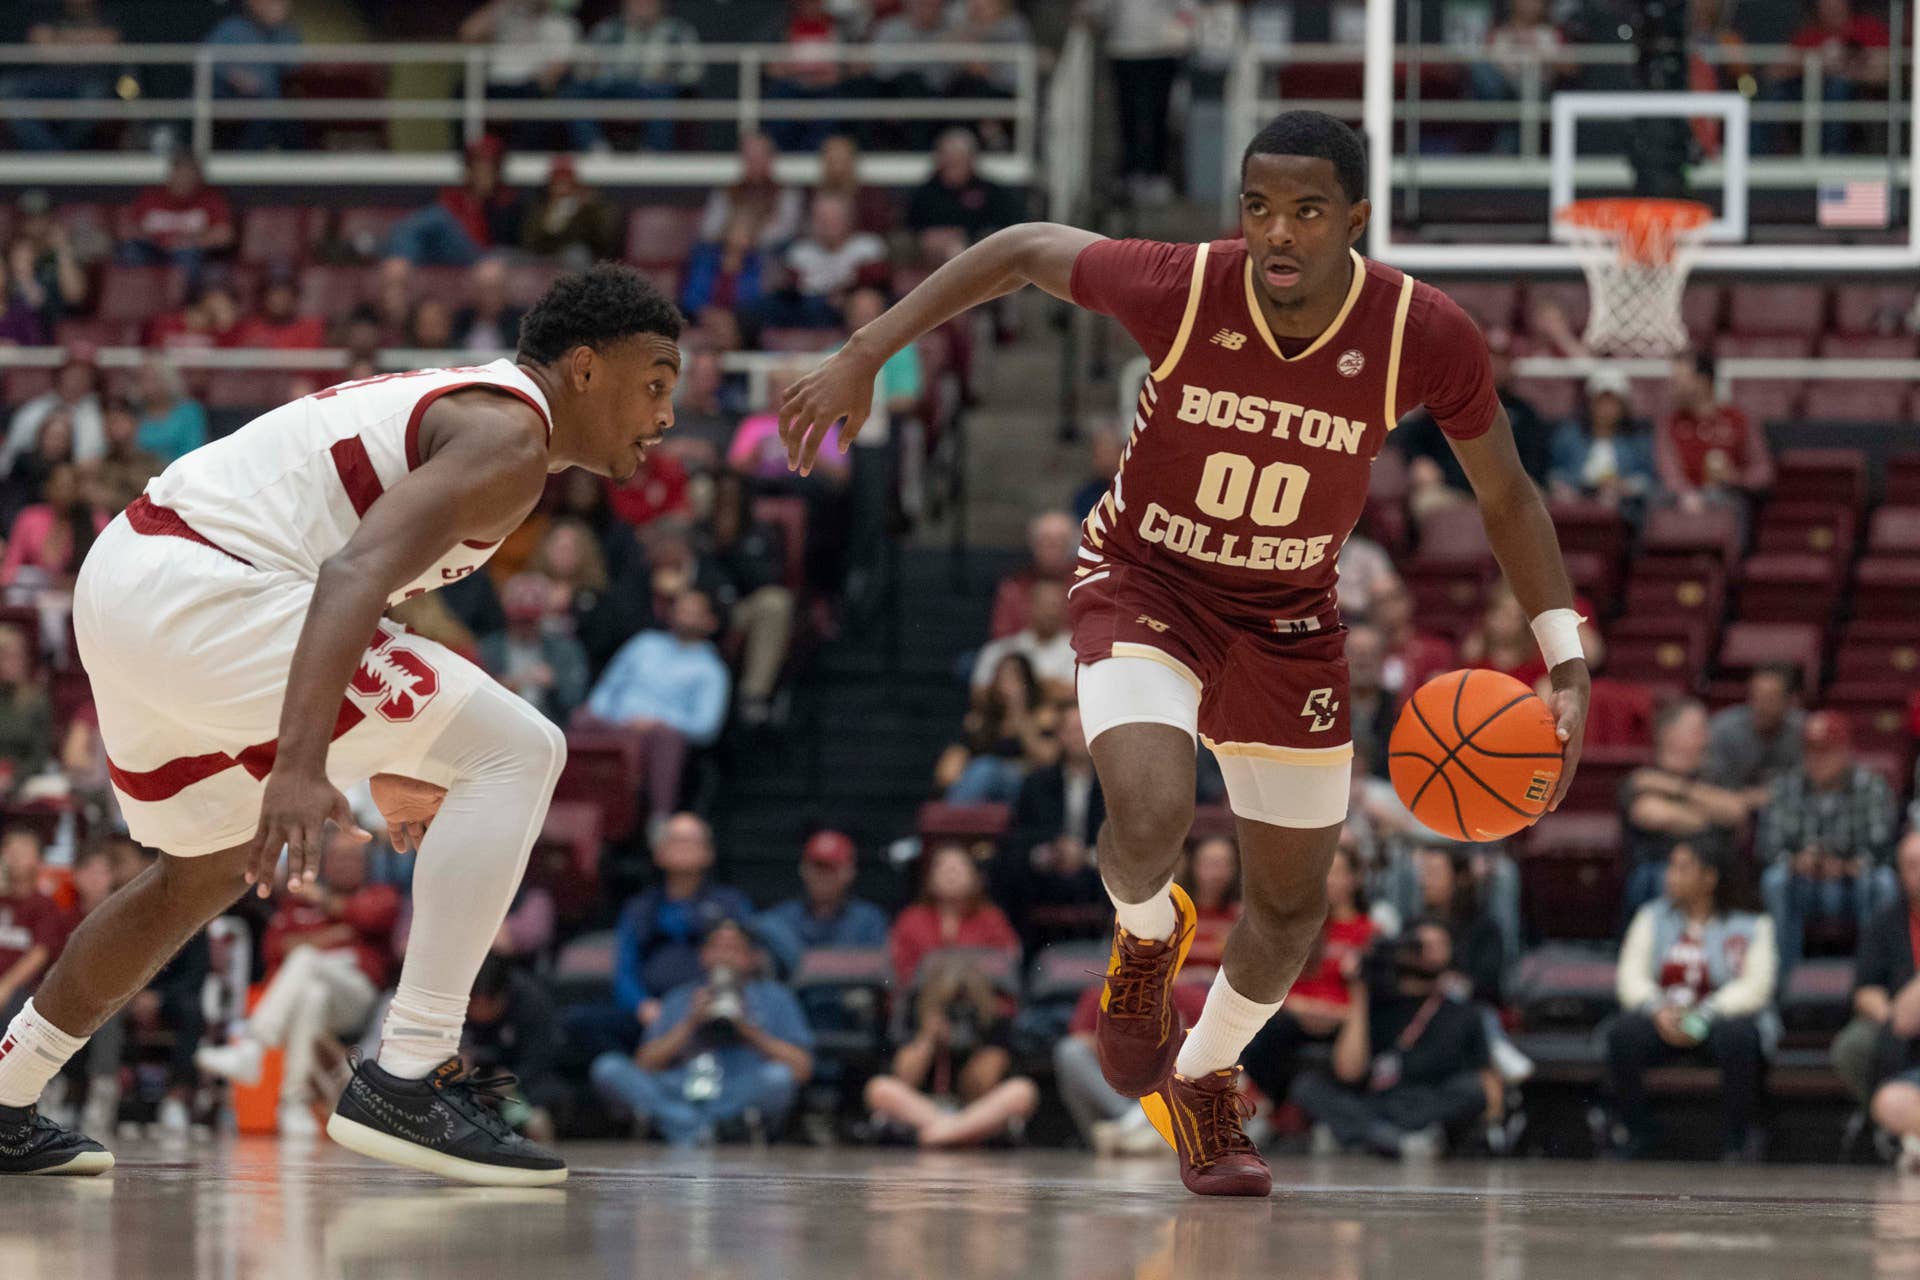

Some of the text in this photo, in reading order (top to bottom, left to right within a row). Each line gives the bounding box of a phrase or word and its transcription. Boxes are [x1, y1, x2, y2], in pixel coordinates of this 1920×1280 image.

[1176, 384, 1368, 455] BOSTON
[1194, 451, 1312, 528] 00
[1138, 502, 1334, 572] COLLEGE
